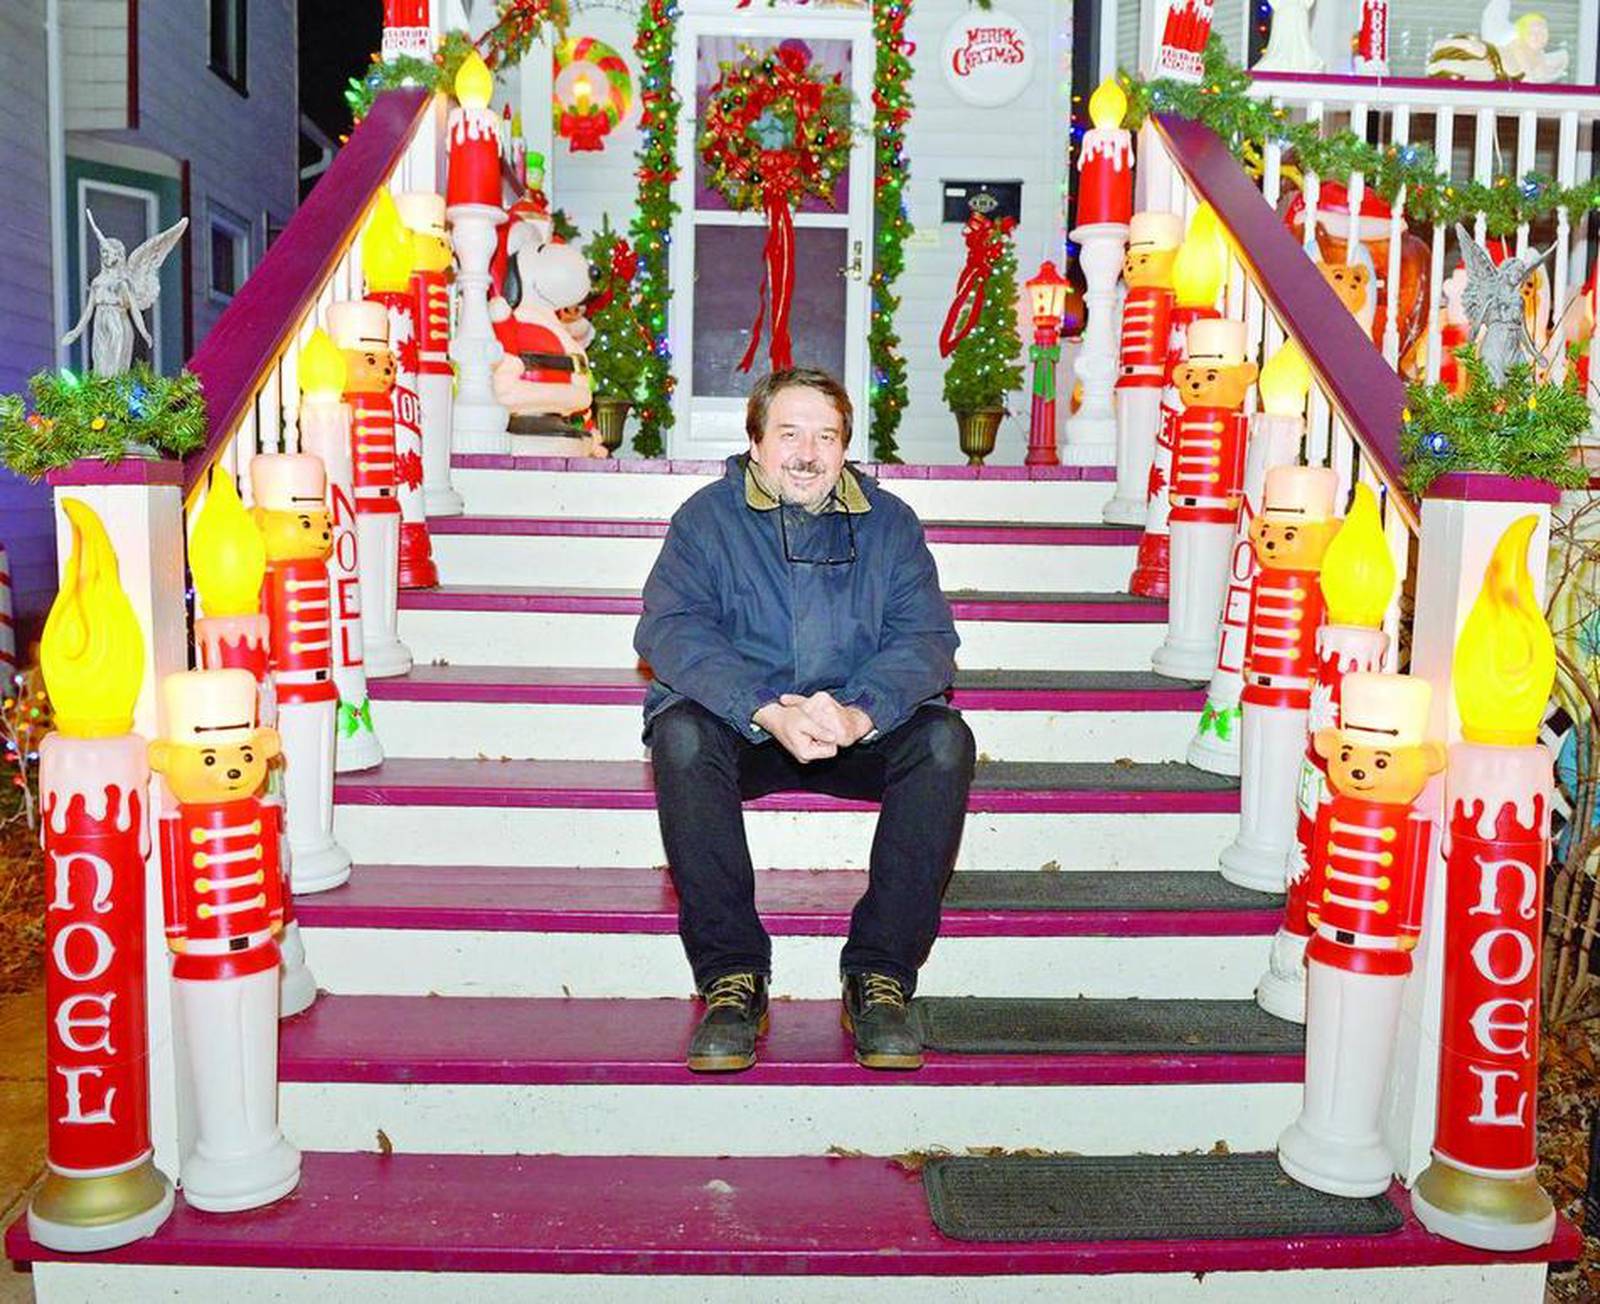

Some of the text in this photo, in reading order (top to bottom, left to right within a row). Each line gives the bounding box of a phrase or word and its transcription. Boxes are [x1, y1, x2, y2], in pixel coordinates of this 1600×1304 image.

[966, 27, 1016, 45] MERRY
[48, 850, 117, 1125] NOEL
[1467, 854, 1537, 1129] NOEL
